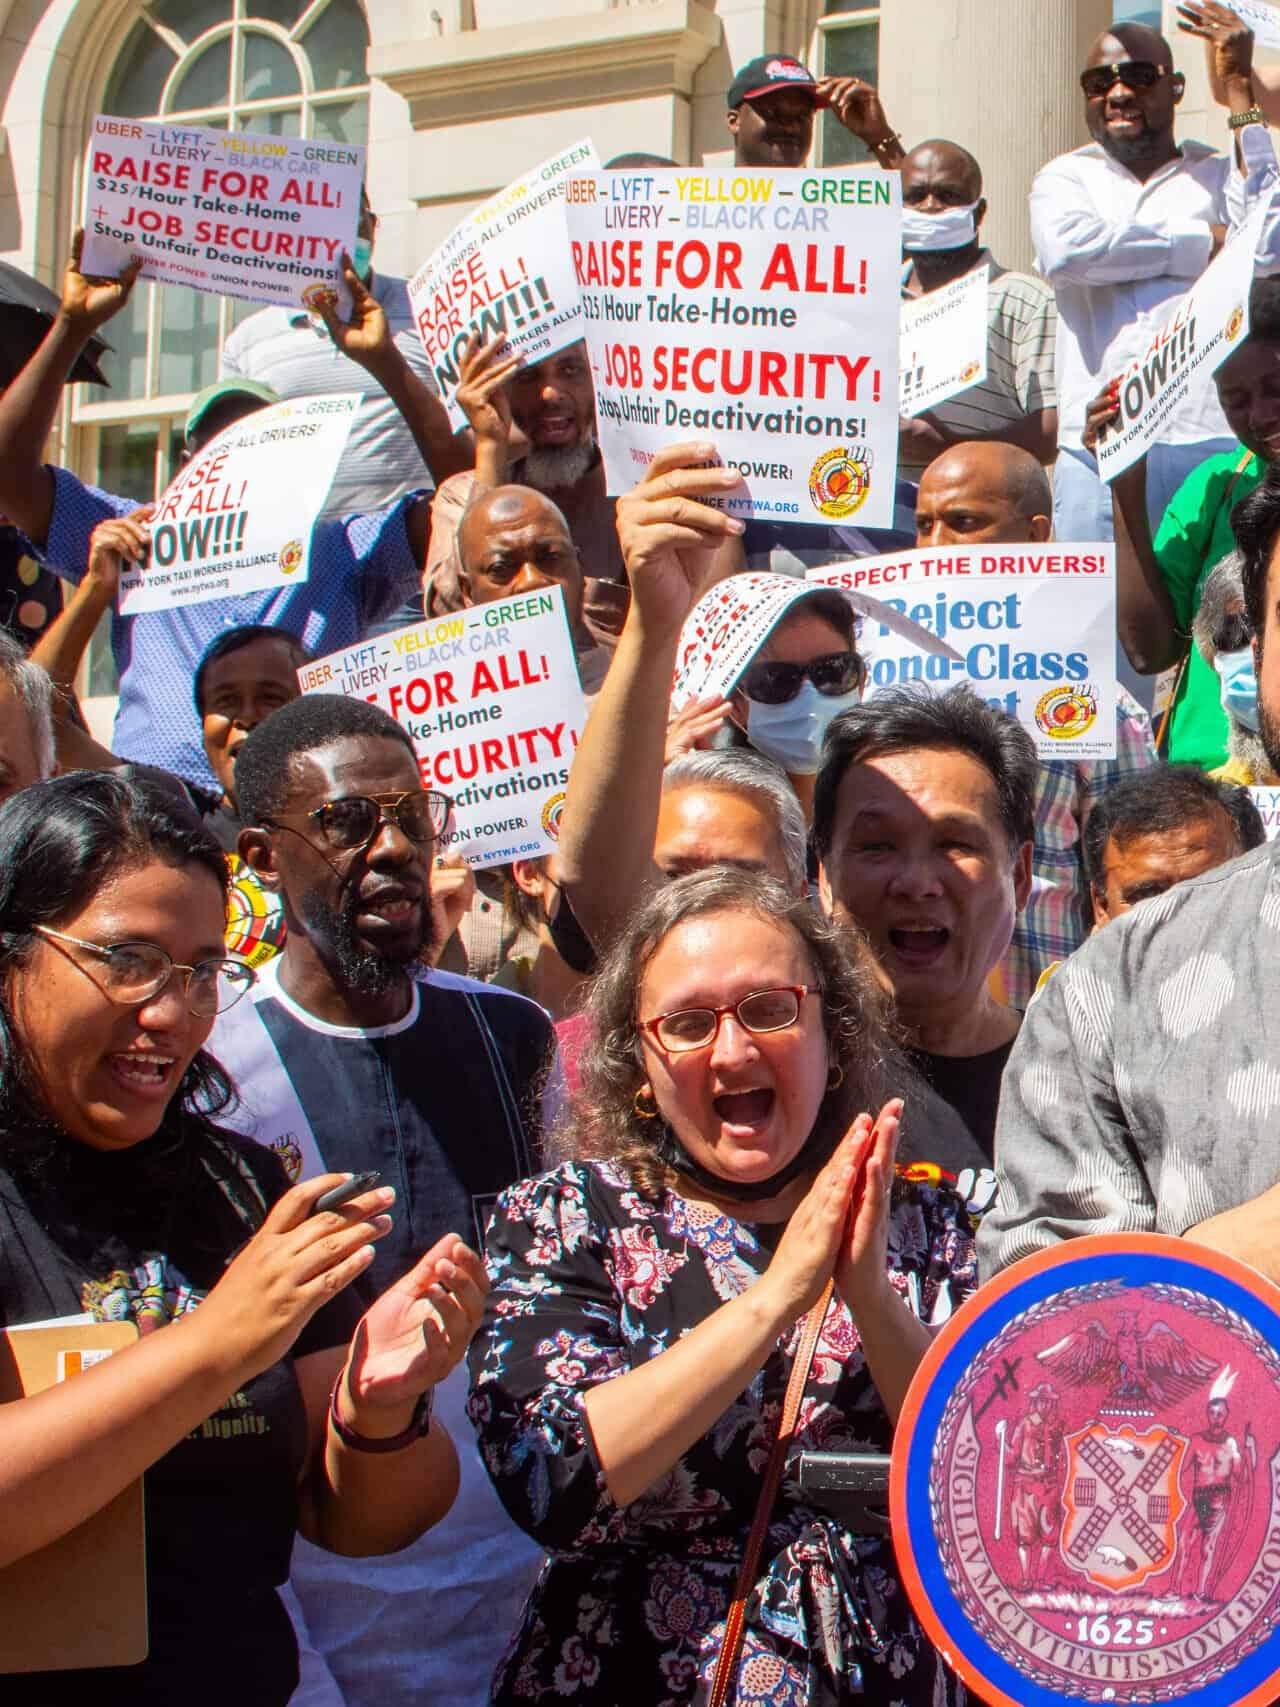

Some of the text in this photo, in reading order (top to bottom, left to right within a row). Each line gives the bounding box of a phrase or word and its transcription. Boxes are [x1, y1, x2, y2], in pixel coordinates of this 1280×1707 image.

[96, 120, 357, 166] UBER LYFT YELLOW GREEN
[151, 144, 319, 175] LIVERY BLACK CAR
[93, 152, 342, 209] RAISE FOR ALL!
[540, 144, 591, 182] GREEN
[96, 178, 301, 223] $25/Hour Take-Home
[565, 177, 890, 205] UBER LYFT YELLOW GREEN
[121, 207, 183, 237] JOB
[481, 223, 504, 242] ALL
[605, 205, 829, 232] LIVERY BLACK CAR
[95, 222, 135, 243] Stop
[141, 232, 200, 257] Unfair
[206, 248, 339, 281] Deactivations!
[571, 240, 867, 294] RAISE FOR ALL!
[211, 273, 249, 288] UNION
[418, 252, 487, 341] RAISE
[425, 307, 464, 364] FOR
[468, 256, 528, 316] ALL!
[648, 295, 796, 327] Take-Home
[605, 343, 881, 402] JOB SECURITY!
[306, 399, 355, 415] GREEN
[1101, 441, 1121, 460] NEW
[1122, 423, 1144, 446] YORK
[1157, 369, 1190, 408] WORKERS
[1191, 328, 1224, 371] ALLIANCE
[598, 391, 866, 438] Stop Unfair Deactivations!
[185, 480, 247, 516] ALL!
[728, 499, 799, 514] NYTWA.ORG
[121, 552, 277, 591] NEW YORK TAXI WORKERS ALLIANCE
[920, 555, 1105, 577] THE DRIVERS!
[300, 595, 554, 691] UBER LYFT YELLOW GREEN
[341, 627, 510, 694] LIVERY BLACK CAR
[389, 650, 550, 720] FOR ALL!
[721, 669, 736, 687] NEW
[951, 1443, 999, 1601] SIGILLVM
[997, 1599, 1153, 1678] CIVITATIS
[1162, 1618, 1237, 1669] NOVI
[1077, 1615, 1153, 1645] 1625
